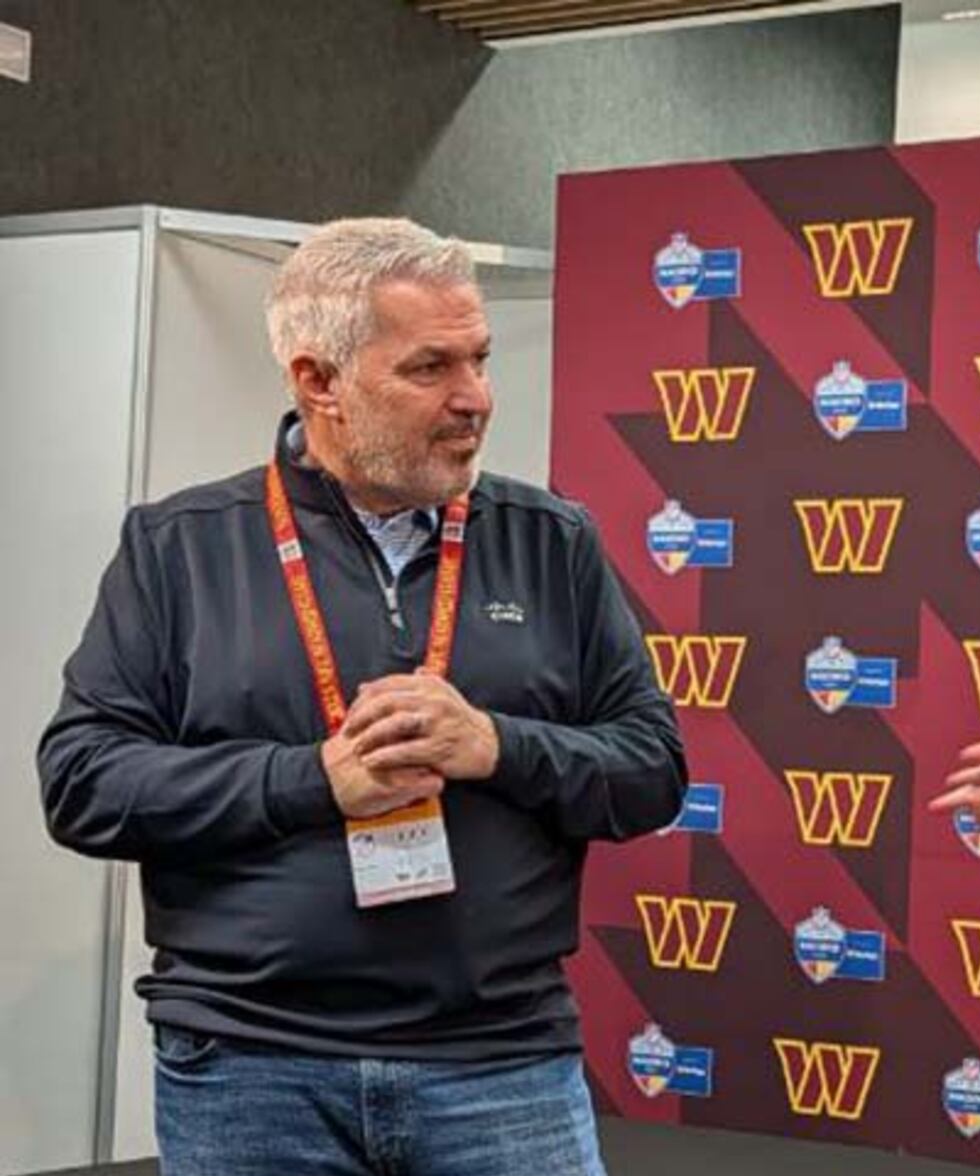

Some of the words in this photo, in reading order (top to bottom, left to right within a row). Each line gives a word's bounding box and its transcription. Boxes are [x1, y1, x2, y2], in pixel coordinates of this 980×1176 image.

[803, 218, 913, 297] W
[653, 367, 756, 442] W
[794, 498, 903, 574] W
[645, 635, 747, 707] W
[784, 770, 892, 847] W
[635, 896, 737, 971] W
[773, 1039, 880, 1120] W
